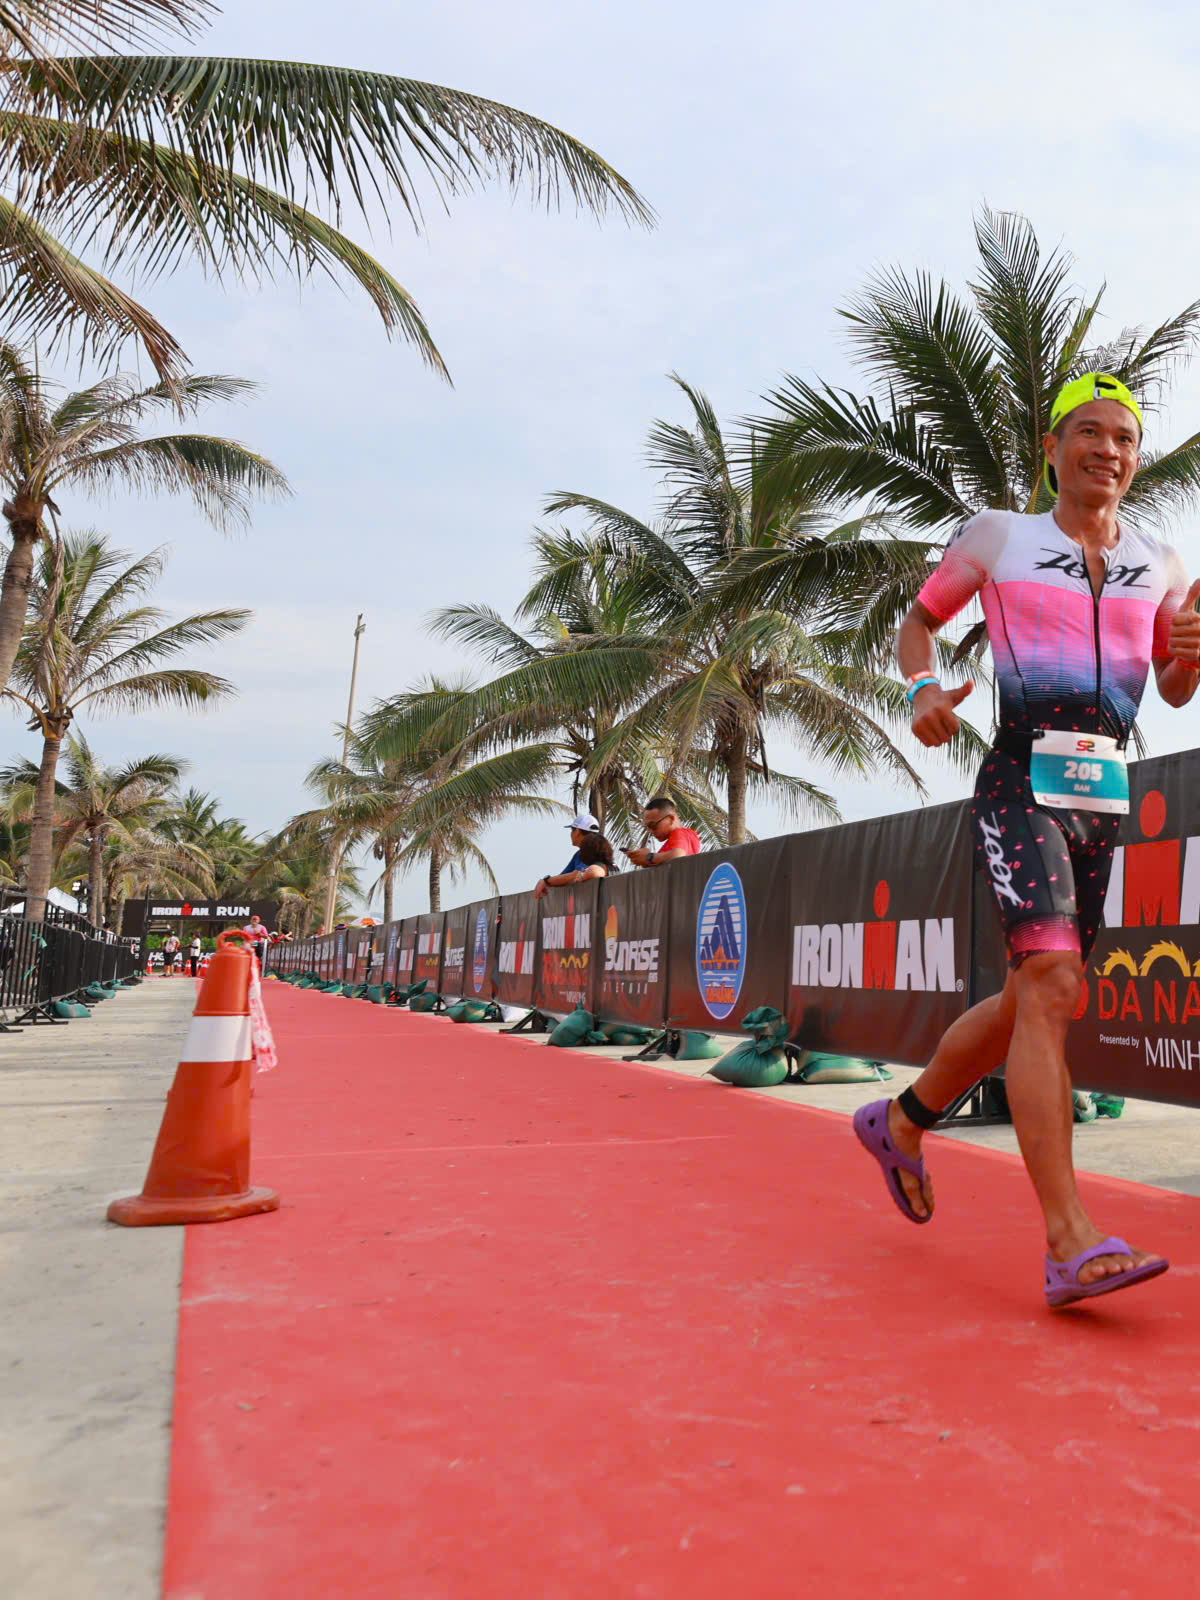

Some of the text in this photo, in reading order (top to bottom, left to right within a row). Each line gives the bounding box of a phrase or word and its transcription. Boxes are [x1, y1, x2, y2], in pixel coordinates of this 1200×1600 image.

[1064, 760, 1103, 782] 205
[152, 903, 250, 916] IRONMAN RUN
[792, 917, 956, 992] IRONMAN
[1098, 978, 1144, 1022] DA
[1099, 1033, 1140, 1049] Presented by
